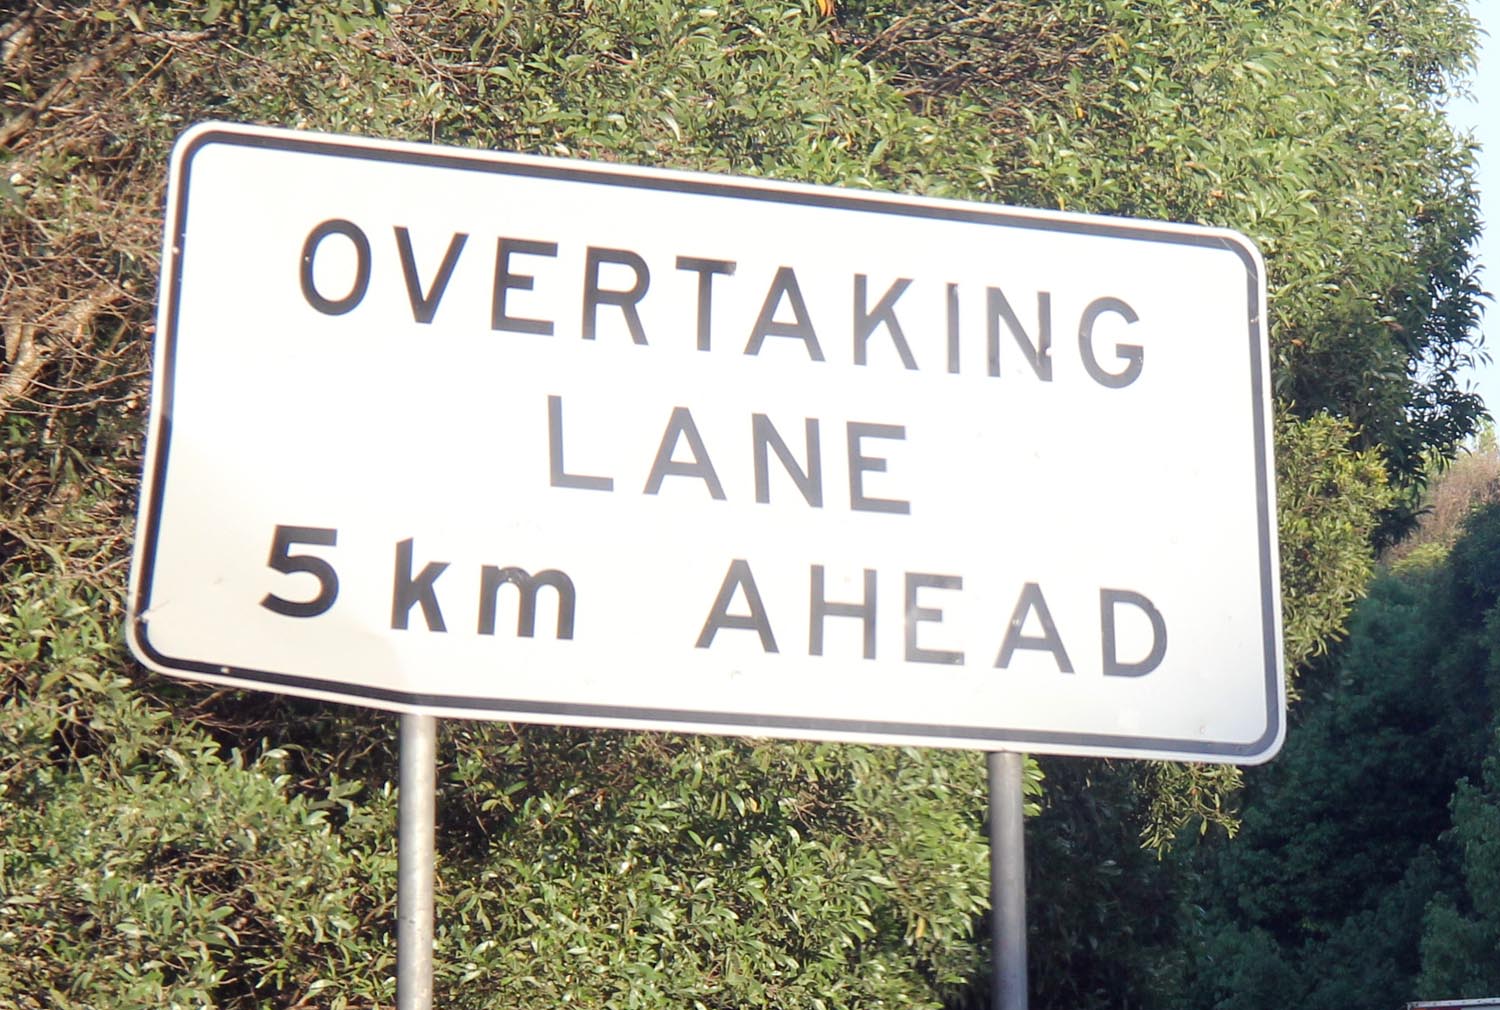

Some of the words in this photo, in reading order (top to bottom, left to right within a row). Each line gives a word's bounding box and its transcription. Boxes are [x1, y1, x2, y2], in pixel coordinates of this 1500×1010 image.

[299, 218, 1144, 389] OVERTAKING
[548, 395, 910, 515] LANE
[259, 524, 340, 619] 5
[391, 537, 576, 641] km
[695, 559, 1168, 678] AHEAD
